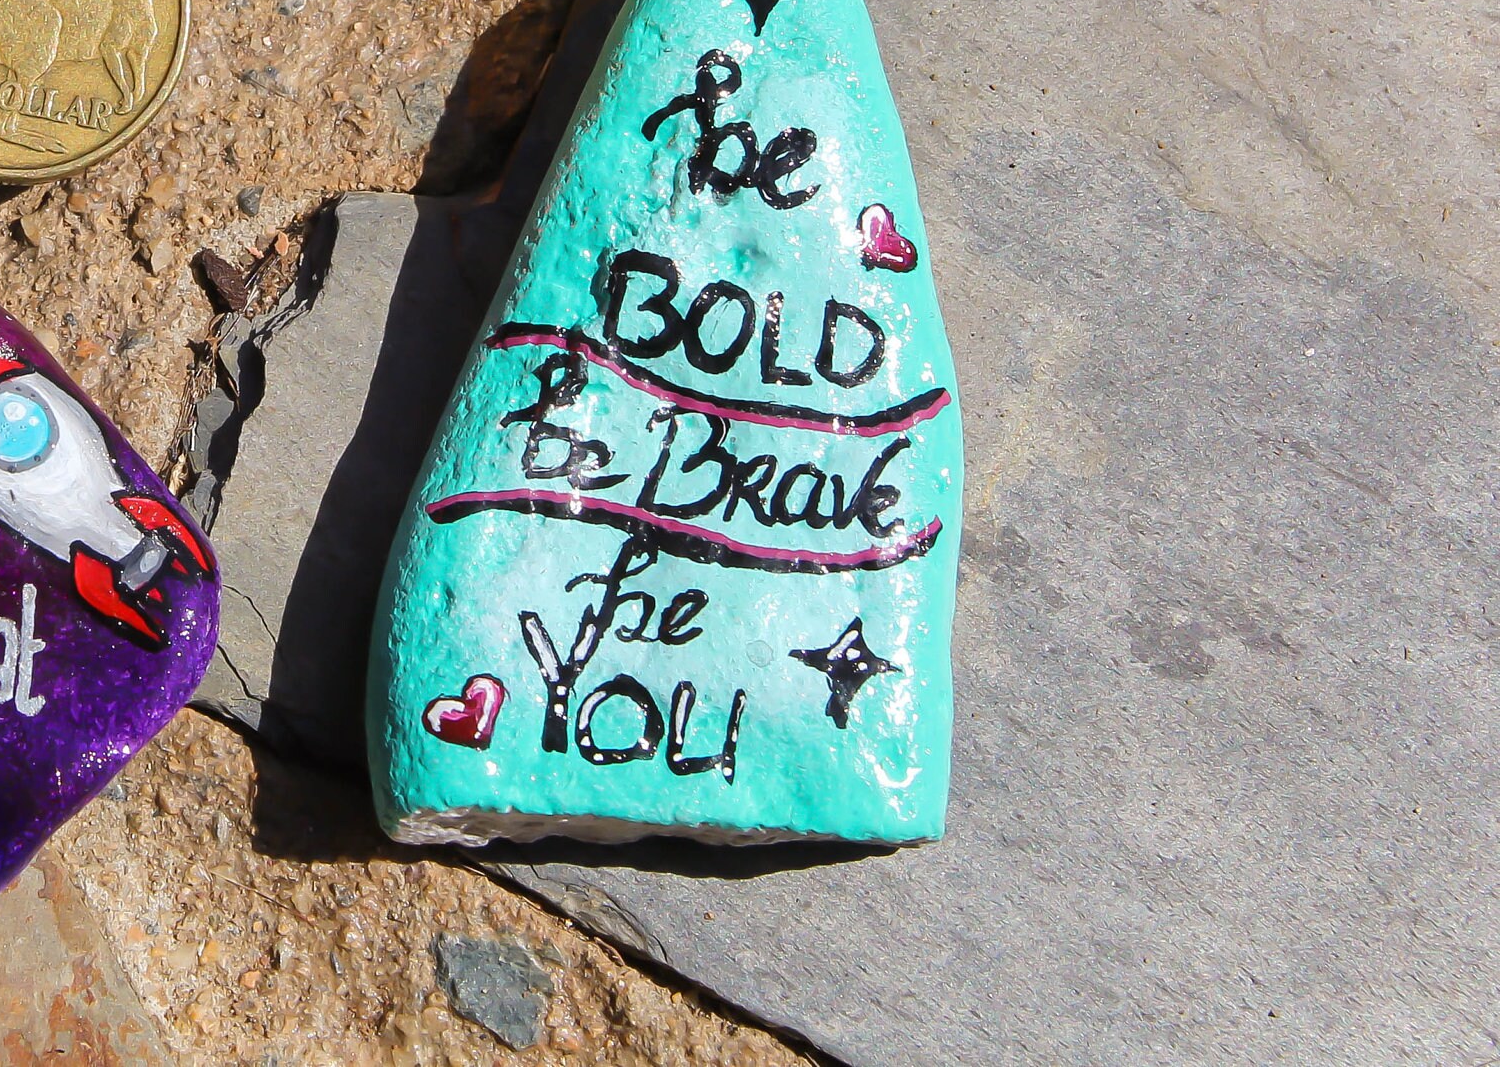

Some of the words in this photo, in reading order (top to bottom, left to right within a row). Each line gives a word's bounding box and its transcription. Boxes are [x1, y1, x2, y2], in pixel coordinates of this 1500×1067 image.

[640, 47, 820, 210] be
[592, 249, 885, 389] BOLD
[520, 611, 746, 784] YOU
